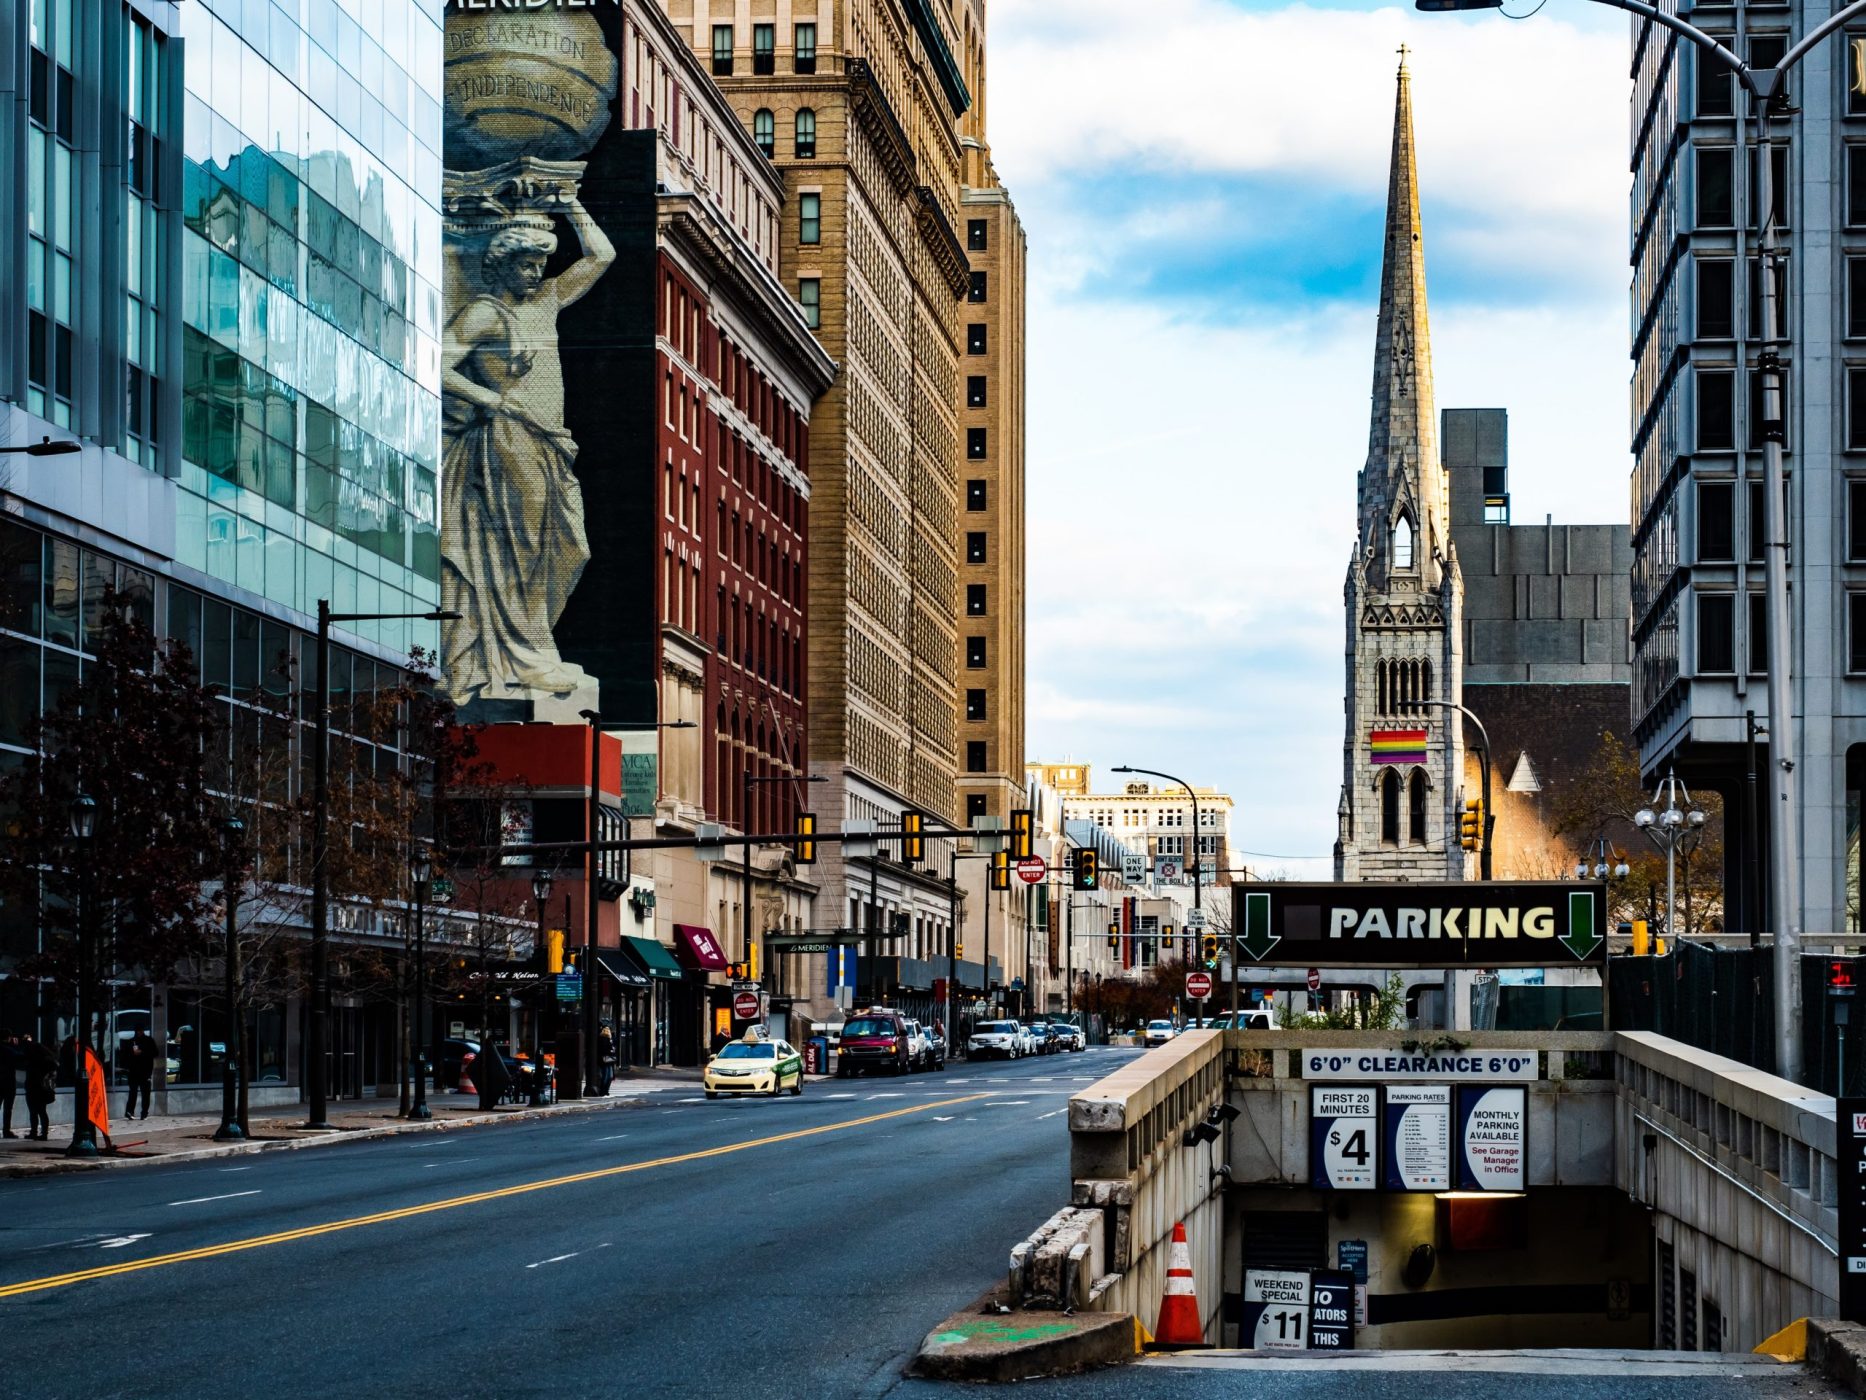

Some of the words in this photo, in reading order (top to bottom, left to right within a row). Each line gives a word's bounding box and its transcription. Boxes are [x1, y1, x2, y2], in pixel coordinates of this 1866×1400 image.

[449, 24, 586, 60] DECLARATION
[462, 74, 592, 123] INDEPENDENCE
[1126, 857, 1142, 865] ONE
[1126, 865, 1142, 873] WAY
[1330, 907, 1554, 939] PARKING
[1358, 1056, 1483, 1072] CLEARANCE
[1322, 1094, 1354, 1103] FIRST
[1357, 1094, 1370, 1103] 20
[1320, 1105, 1370, 1114] MINUTES
[1474, 1111, 1519, 1119] MONTHLY
[1477, 1121, 1519, 1130] PARKING
[1469, 1132, 1519, 1140] AVAILABLE
[1472, 1147, 1487, 1155] See
[1489, 1147, 1519, 1156] Garage
[1483, 1157, 1519, 1166] Manager
[1484, 1165, 1492, 1173] in
[1494, 1165, 1519, 1173] Office
[1254, 1279, 1303, 1290] WEEKEND
[1261, 1290, 1302, 1301] SPECIAL
[1313, 1332, 1339, 1346] THIS
